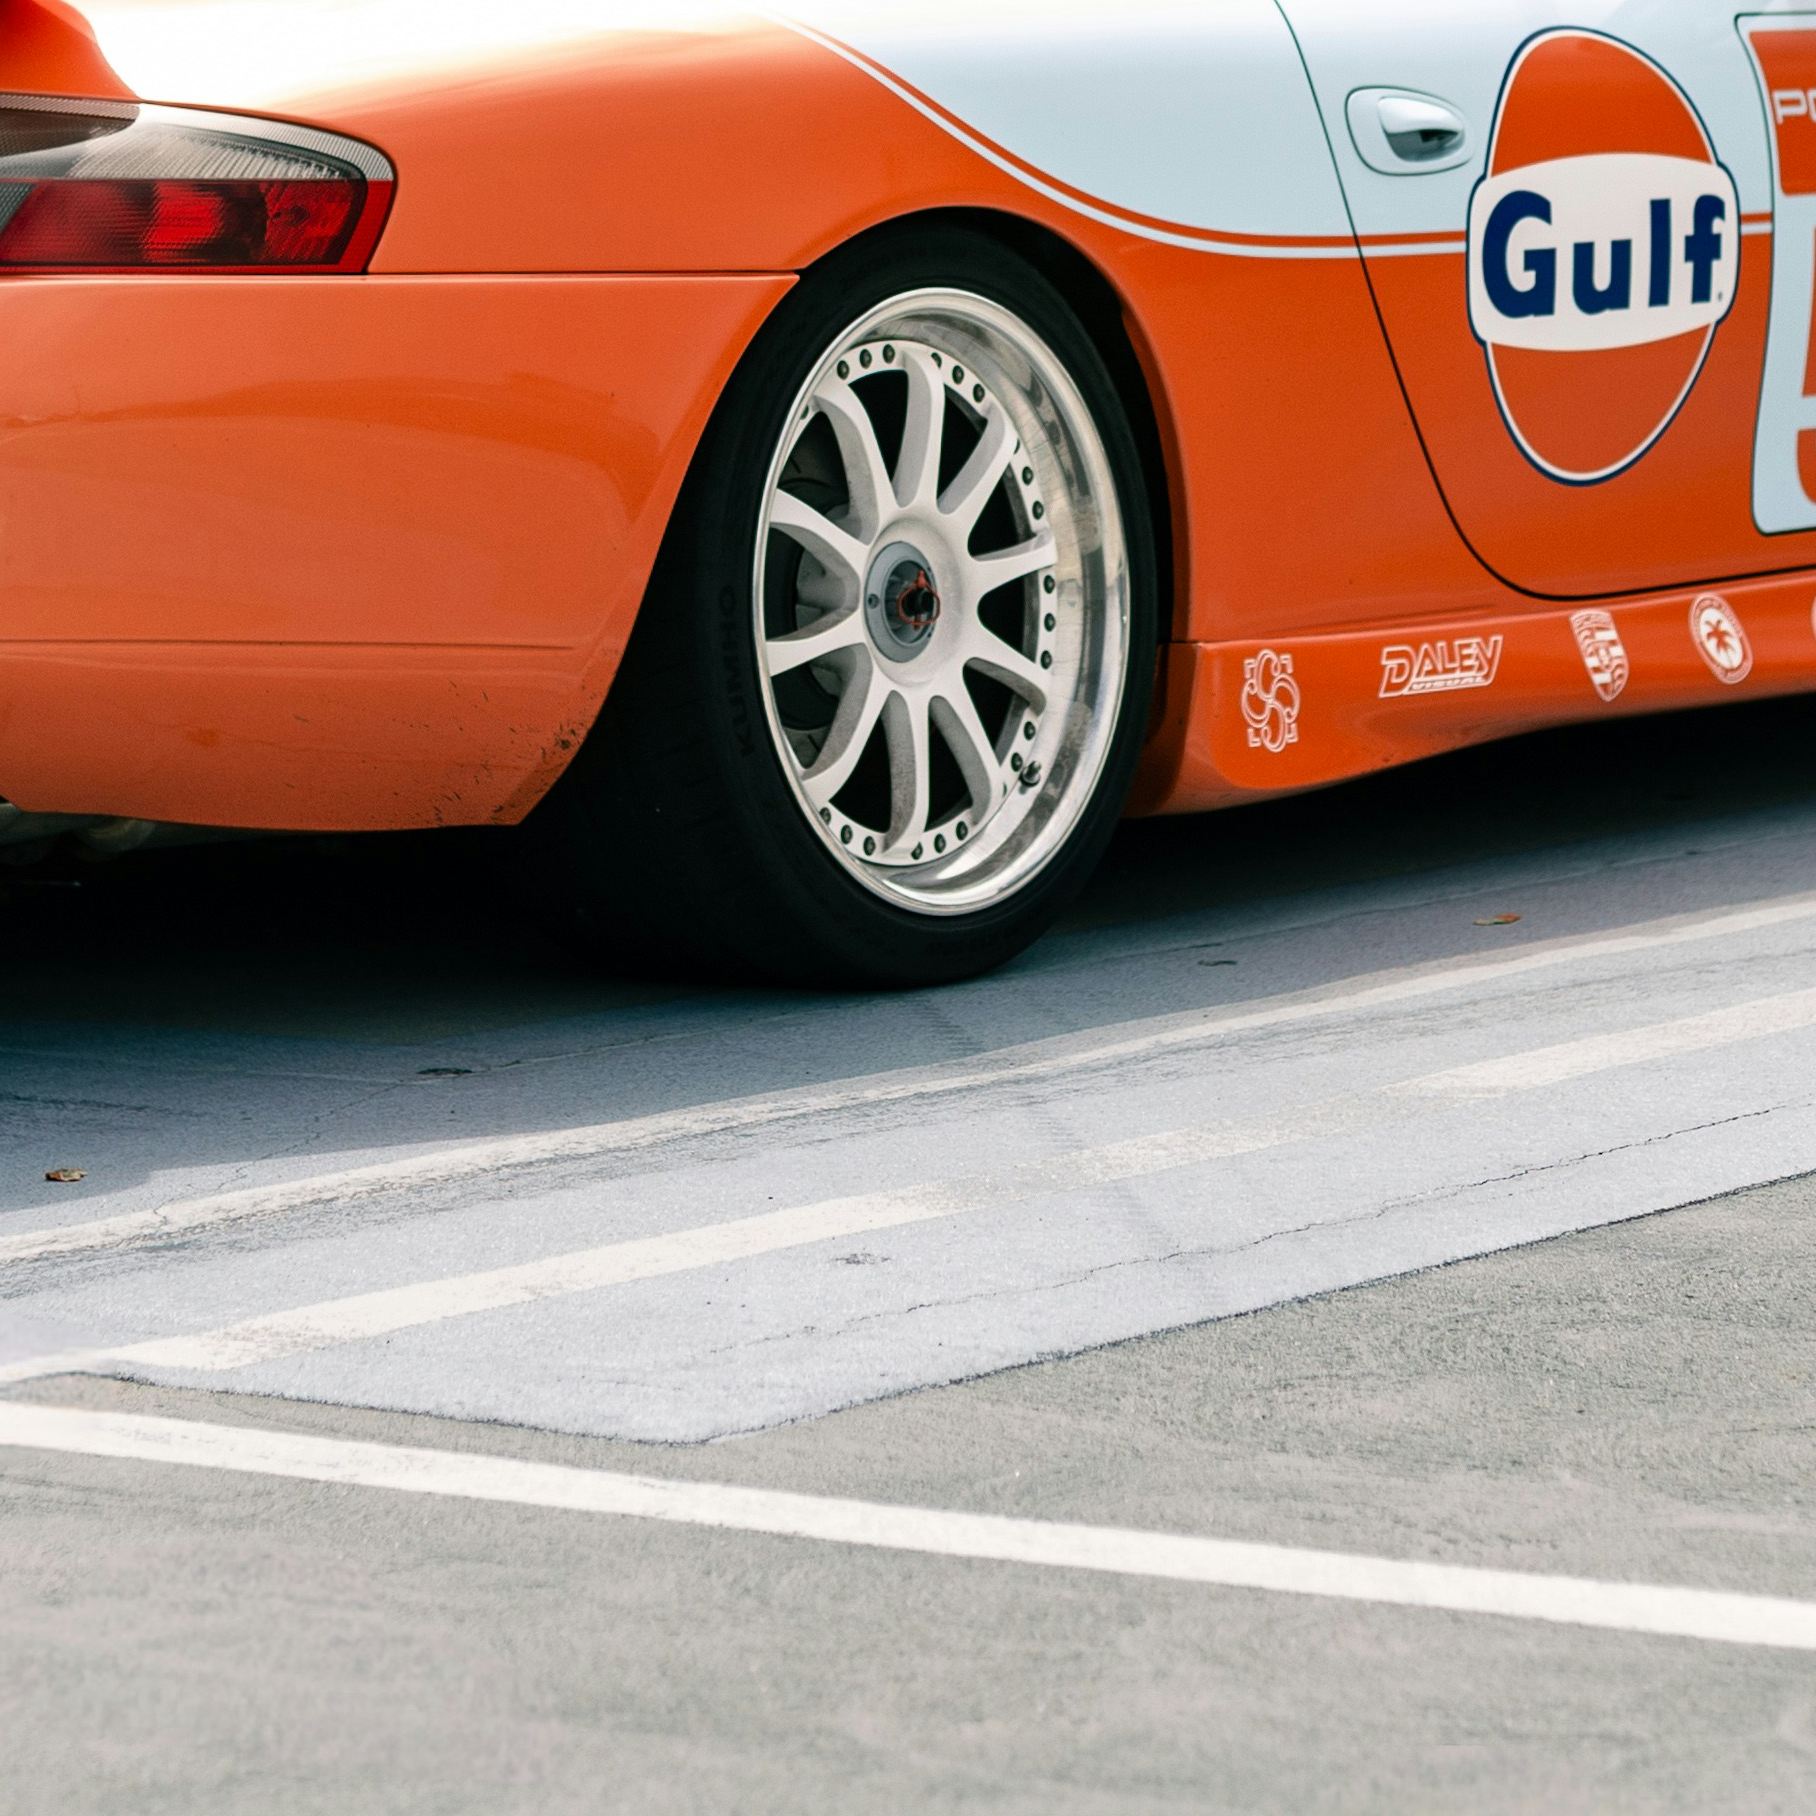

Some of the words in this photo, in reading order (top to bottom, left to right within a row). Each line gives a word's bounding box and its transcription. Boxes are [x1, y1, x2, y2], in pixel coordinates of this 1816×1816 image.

[1482, 190, 1726, 319] Gulf
[718, 583, 756, 759] KUMHO
[1378, 634, 1504, 698] DALEY
